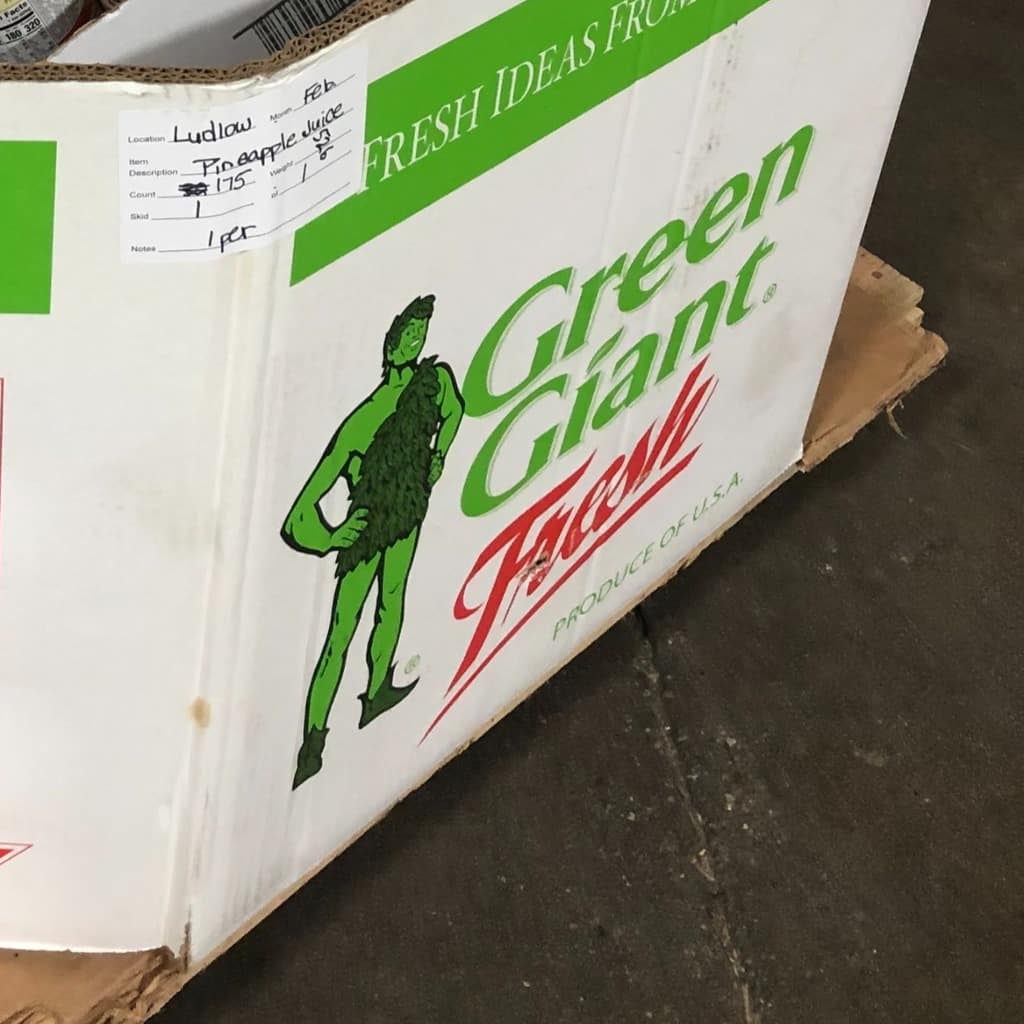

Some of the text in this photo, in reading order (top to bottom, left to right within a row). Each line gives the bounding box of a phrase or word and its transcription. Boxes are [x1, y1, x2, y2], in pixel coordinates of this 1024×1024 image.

[4, 29, 23, 42] 180
[24, 17, 41, 34] 320
[269, 107, 293, 122] Month
[356, 87, 487, 196] FRESH
[489, 21, 600, 119] IDEAS
[128, 134, 166, 144] Location
[172, 117, 253, 145] Ludlow
[191, 132, 297, 178] Pineapple
[301, 102, 345, 139] Juice
[128, 167, 179, 178] Description
[215, 168, 253, 193] 175
[269, 159, 295, 178] Weight
[129, 190, 157, 199] Count
[129, 212, 150, 221] Skid
[130, 244, 157, 253] Notes
[219, 225, 257, 254] per
[463, 123, 816, 419] Green
[459, 235, 776, 519] Giant
[444, 352, 720, 698] Fresh
[550, 471, 744, 642] PRODUCE OF U.S.A.
